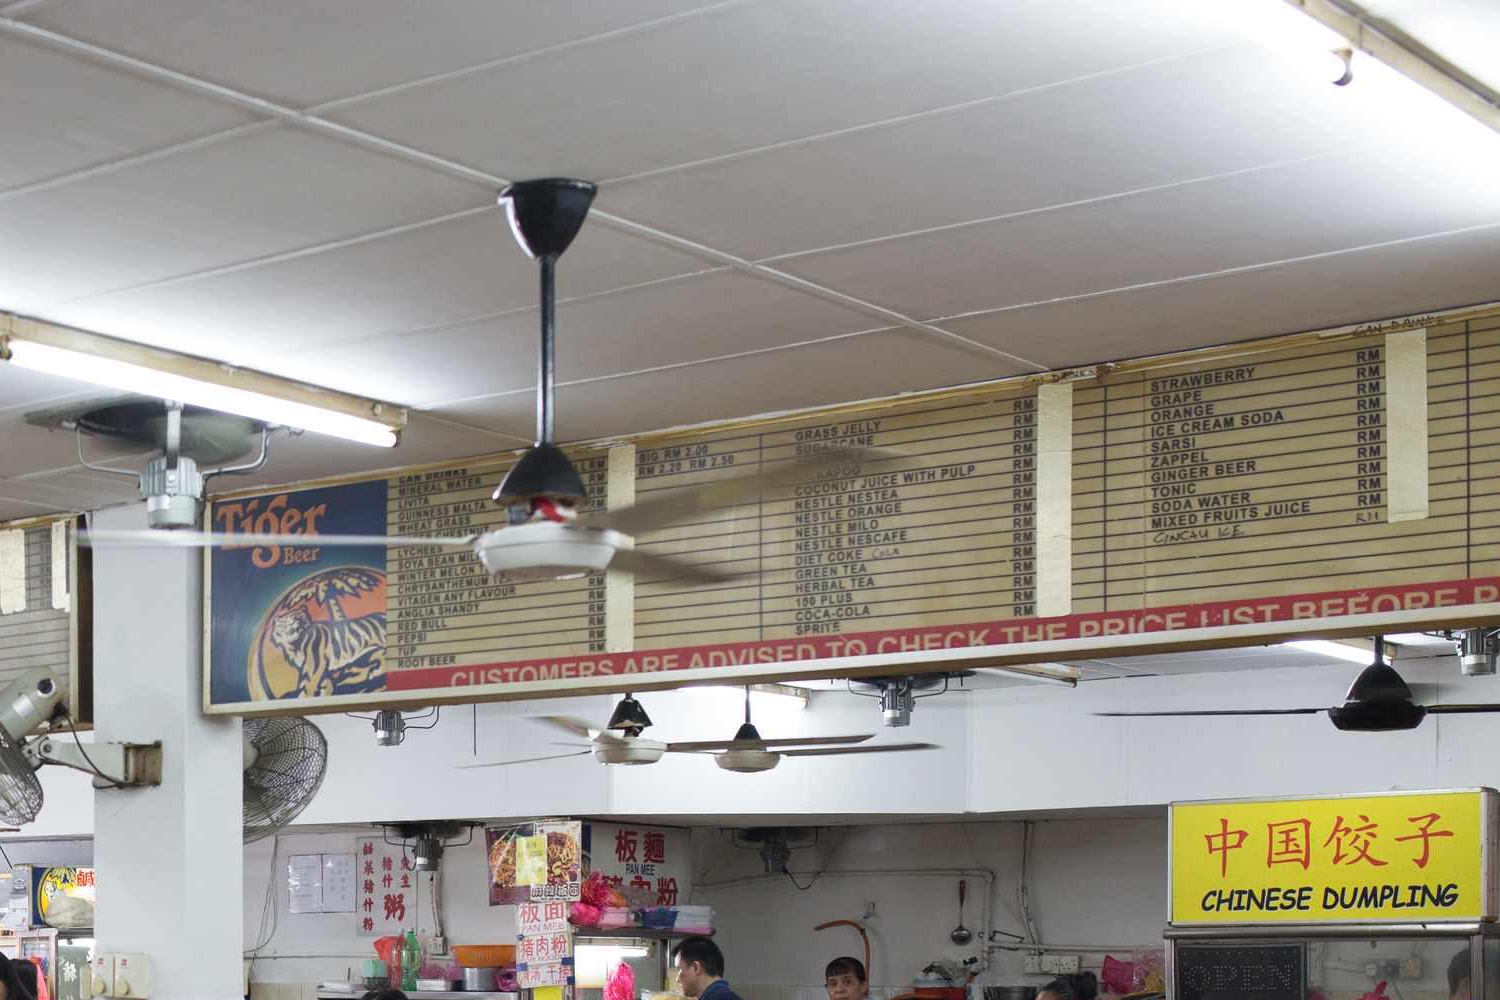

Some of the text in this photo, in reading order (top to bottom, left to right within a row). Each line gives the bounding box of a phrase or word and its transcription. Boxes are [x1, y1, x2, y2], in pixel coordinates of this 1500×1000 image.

[1151, 367, 1255, 392] STRAWBERRY
[1151, 391, 1203, 407] GRAPE
[1151, 404, 1215, 422] ORANGE
[795, 420, 880, 442] GRASS JELLY
[1151, 410, 1284, 438] ICE CREAM SODA
[639, 445, 708, 463] BIG RM 2.00
[795, 436, 874, 456] SUGARCANE
[1151, 437, 1196, 453] SARSI
[638, 455, 734, 476] RM 2.20 RM 2.50
[1151, 451, 1209, 468] ZAPPEL
[1151, 460, 1256, 483] GINGER BEER
[398, 477, 481, 496] MINERAL WATER
[795, 465, 976, 498] COCONUT JUICE WITH PULP
[1152, 483, 1197, 498] TONIC
[398, 497, 429, 509] LIVITA
[795, 489, 899, 510] NESTLE NESTEA
[1152, 492, 1251, 513] SODA WATER
[398, 501, 487, 521] GUINNESS MALTA
[795, 502, 902, 525] NESTLE ORANGE
[1152, 501, 1311, 529] MIXED FRUITS JUICE
[216, 494, 327, 569] Tiger
[398, 516, 472, 533] WHEAT GRASS
[795, 519, 879, 538] NESTLE MILO
[795, 531, 908, 552] NESTLE NESCAFE
[283, 547, 320, 565] Beer
[398, 545, 443, 558] LYCHEES
[795, 550, 863, 566] DIET COKE
[398, 560, 424, 571] SOYA
[428, 556, 454, 568] BEAN
[795, 563, 868, 581] GREEN TEA
[398, 570, 436, 582] WINTER
[440, 565, 475, 578] MELON
[398, 578, 489, 595] CHRYSANTHEMUM
[795, 576, 875, 594] HERBAL TEA
[398, 587, 516, 607] VITAGEN ANY FLAVOUR
[795, 592, 853, 608] 100 PLUS
[398, 603, 480, 619] ANGLIA SHANDY
[795, 605, 871, 622] COCA-COLA
[398, 619, 447, 632] RED BULL
[795, 621, 840, 636] SPRITE
[398, 634, 426, 644] PEPSI
[398, 646, 416, 656] 7UP
[451, 659, 613, 687] CUSTOMERS
[624, 654, 679, 674] ARE
[689, 643, 816, 670] ADVISED
[825, 637, 867, 659] TO
[877, 628, 986, 655] CHECK
[1001, 622, 1066, 645] THE
[1079, 611, 1187, 637] PRICE
[398, 655, 456, 669] ROOT BEER
[615, 828, 665, 864] 板麵
[1204, 812, 1455, 878] 中国饺子
[626, 863, 655, 876] PAN MEE
[1201, 884, 1459, 912] CHINESE DUMPLING
[520, 901, 564, 924] 板面
[522, 922, 564, 933] PAN MEE
[521, 934, 567, 958] 猪肉粉
[1185, 964, 1293, 991] OPEN
